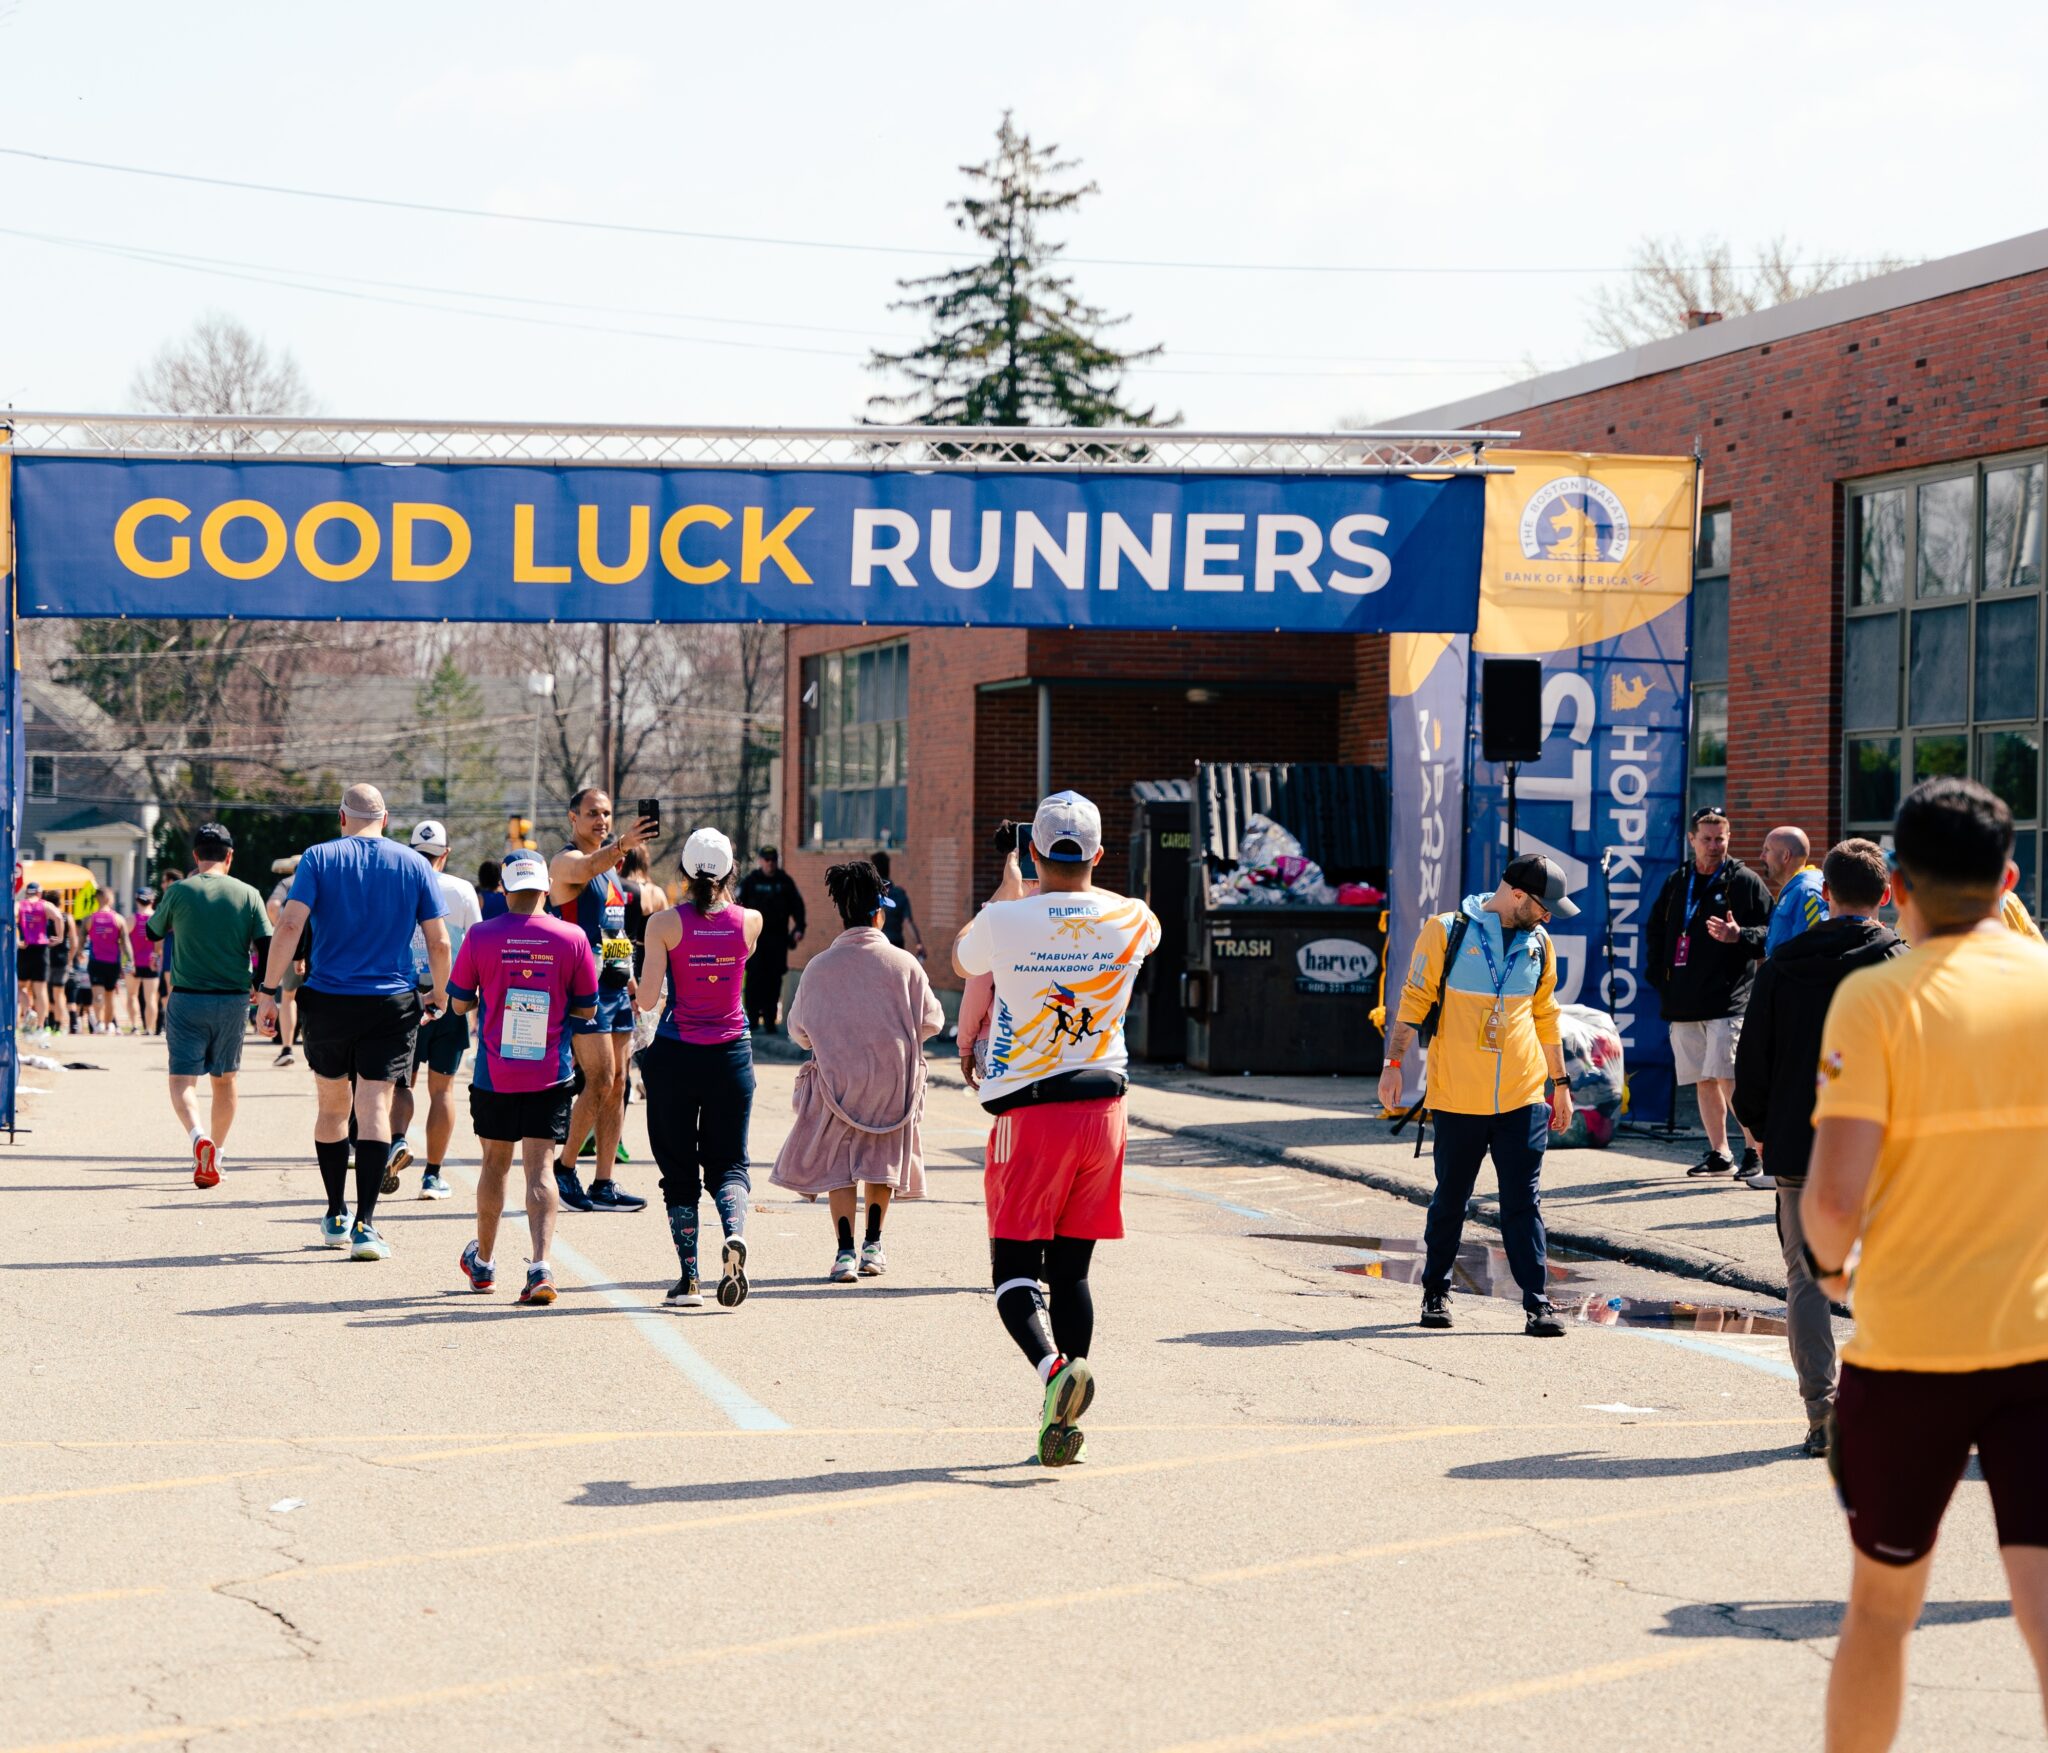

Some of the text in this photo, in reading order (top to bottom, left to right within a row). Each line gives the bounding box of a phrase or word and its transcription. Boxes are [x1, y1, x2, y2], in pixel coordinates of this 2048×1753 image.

[1523, 480, 1628, 553] THE BOSTON MARATHON
[113, 497, 1392, 595] GOOD LUCK RUNNERS
[1504, 571, 1629, 586] BANK OF AMERICA
[1599, 725, 1650, 1048] HOPKINTON
[1048, 907, 1099, 917] PILIPINAS
[1092, 952, 1115, 961] ANG
[1214, 939, 1272, 958] TRASH
[1014, 964, 1094, 973] MANANAKBONG
[1305, 948, 1373, 979] harvey
